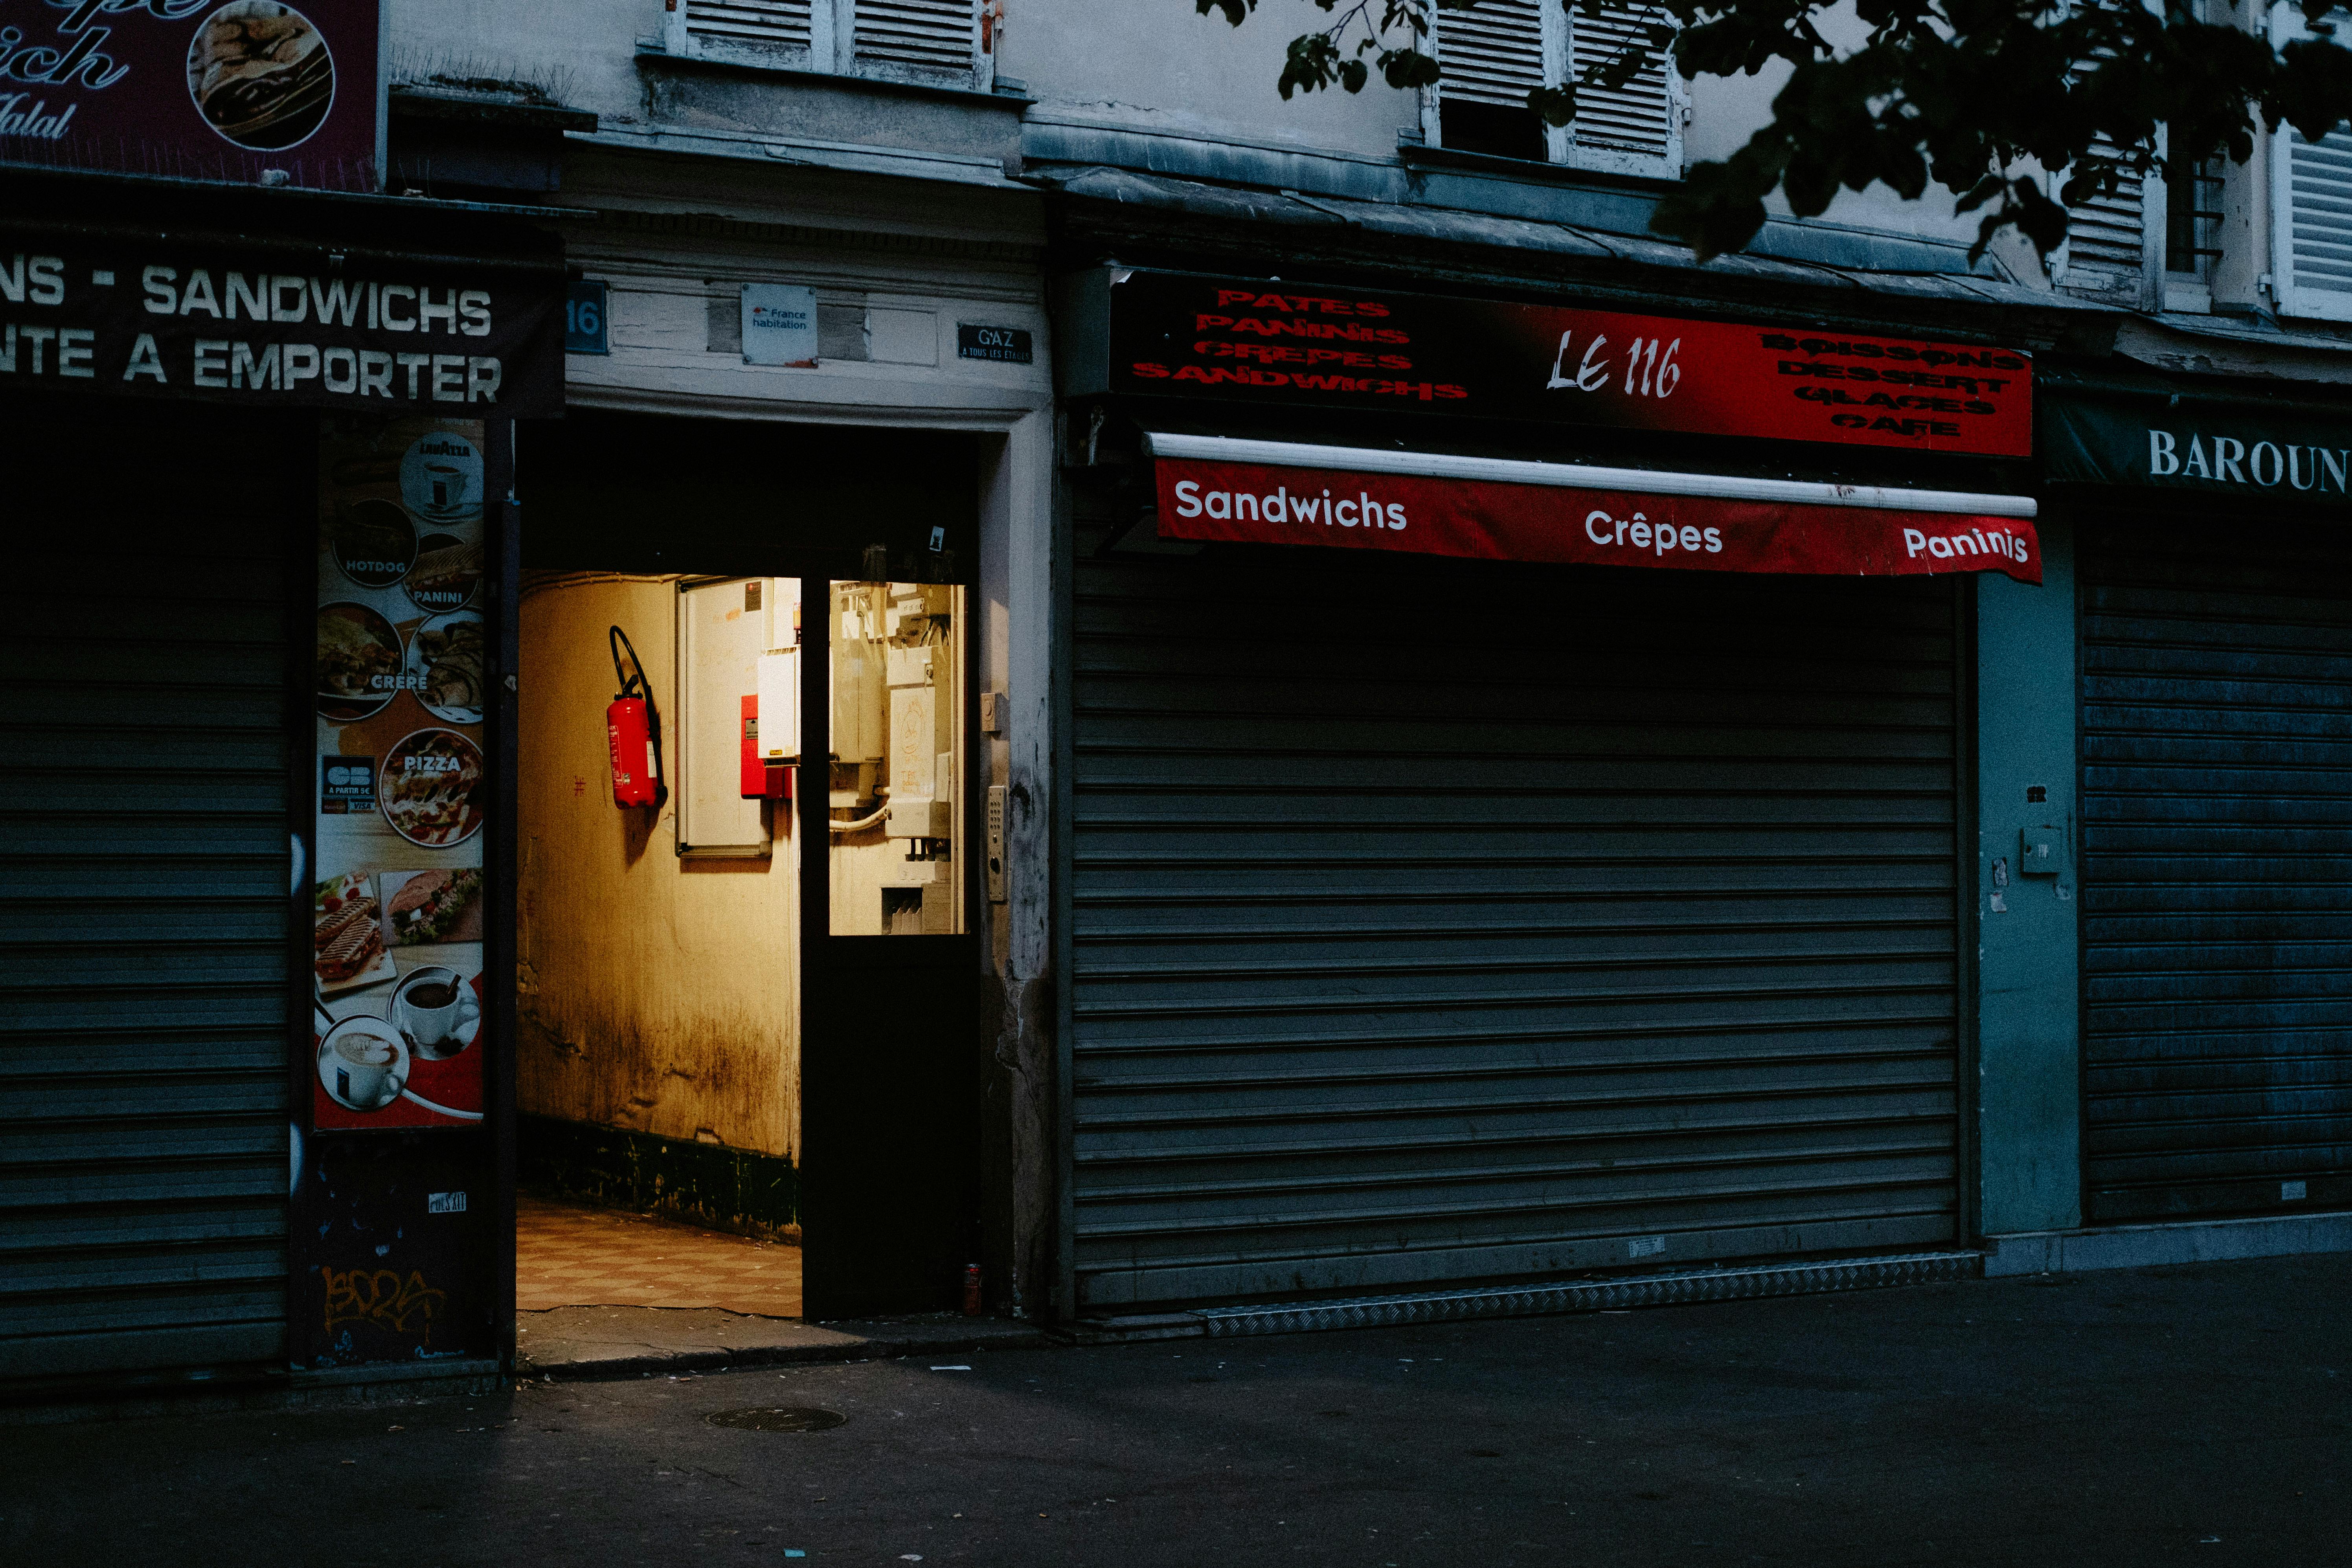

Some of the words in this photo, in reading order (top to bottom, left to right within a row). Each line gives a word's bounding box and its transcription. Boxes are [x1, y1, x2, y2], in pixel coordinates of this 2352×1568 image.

[142, 263, 491, 336] SANDWICHS
[771, 308, 806, 319] France
[1218, 290, 1391, 317] PATES
[753, 318, 807, 330] habitation
[978, 329, 1014, 347] GAZ
[1196, 314, 1410, 344] PANINIS
[963, 346, 967, 356] A
[970, 347, 987, 357] TOUS
[990, 349, 1001, 358] LES
[1193, 340, 1413, 370] CREPES
[1546, 329, 1611, 392] LE
[1626, 336, 1681, 399] 116
[1762, 334, 2025, 370] BOISSONS
[123, 333, 167, 384] A
[194, 338, 502, 403] EMPORTER
[1131, 362, 1469, 401] SANDWICHS
[1777, 360, 2012, 395] DESSERT
[2148, 429, 2352, 494] BAROUN
[1175, 480, 1408, 531] Sandwichs
[1585, 510, 1723, 557] Crêpes
[1903, 528, 2029, 564] Paninis
[346, 560, 406, 573] HOTDOG
[413, 591, 463, 604] PANINI
[371, 671, 428, 690] CRÊPE
[404, 756, 461, 772] PIZZA
